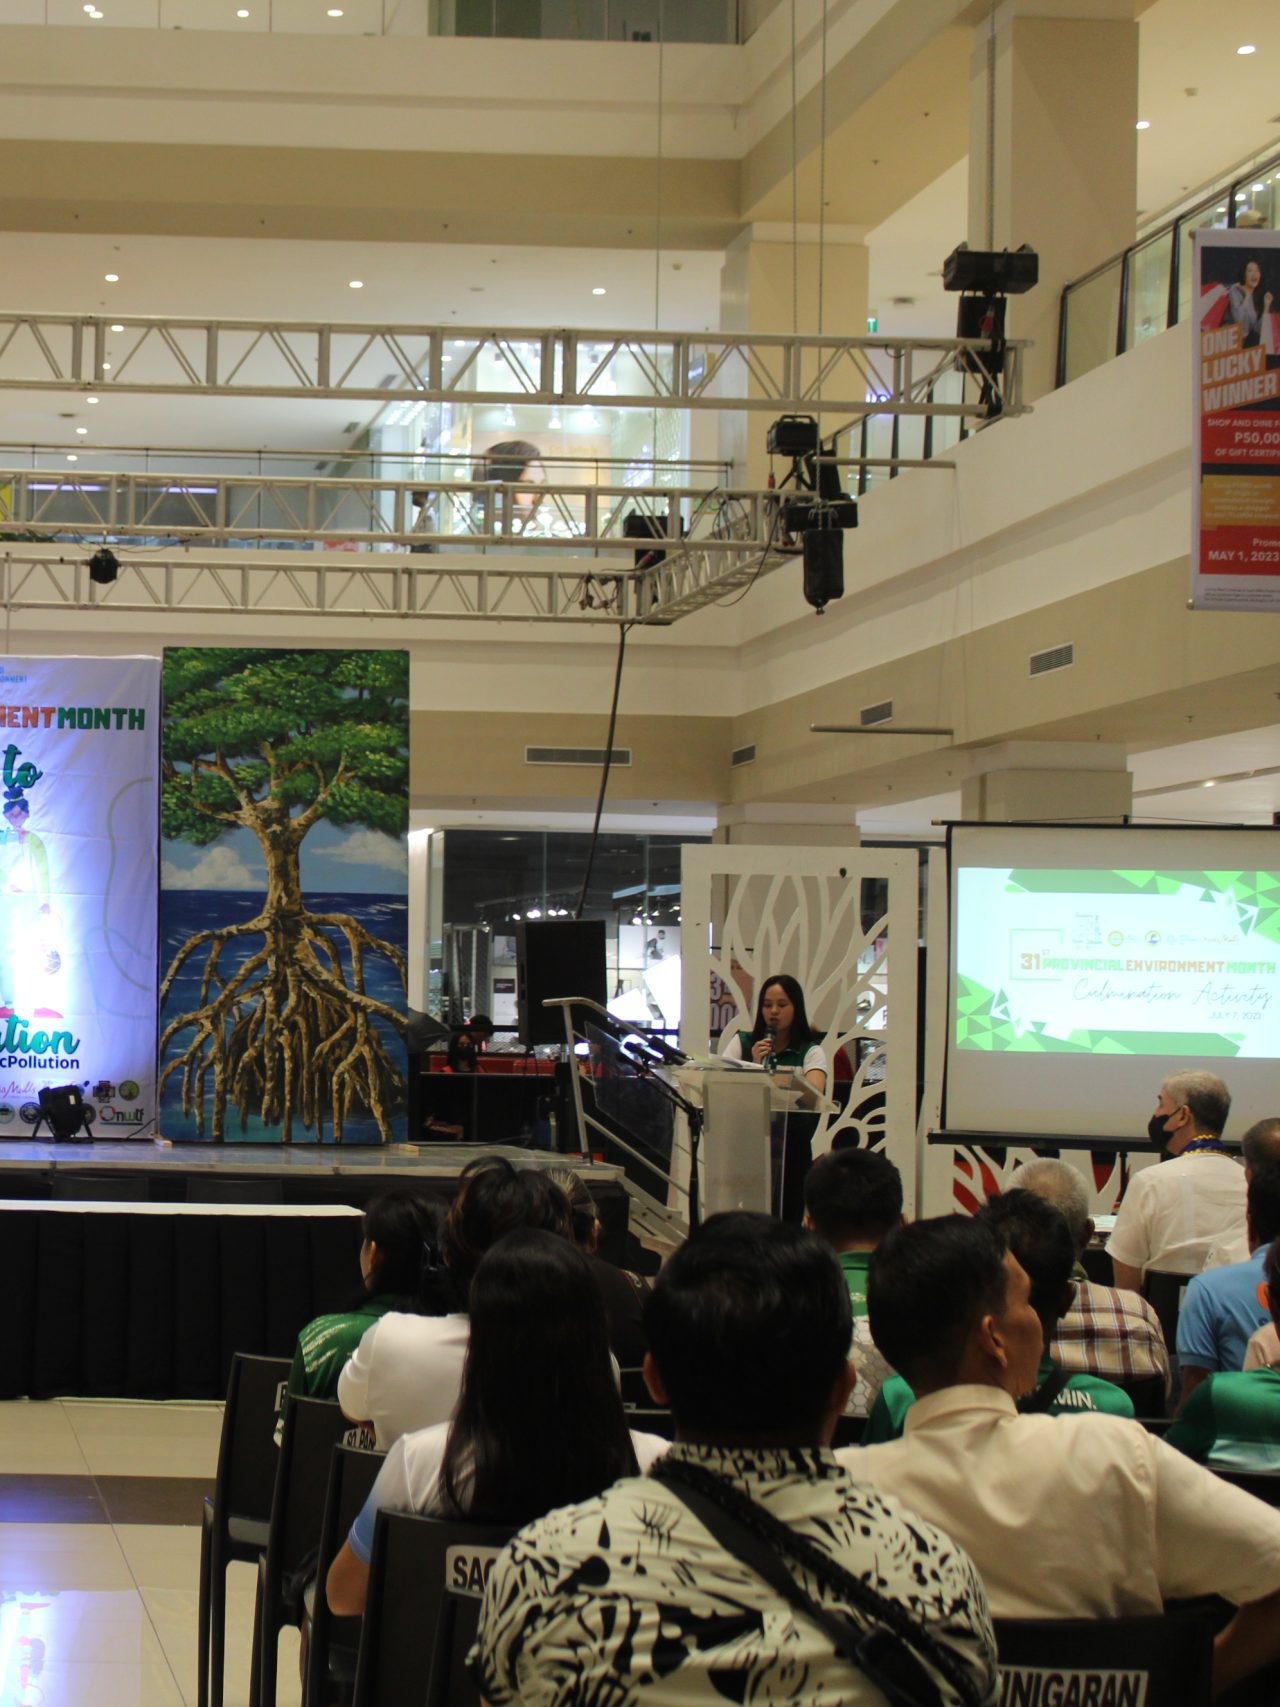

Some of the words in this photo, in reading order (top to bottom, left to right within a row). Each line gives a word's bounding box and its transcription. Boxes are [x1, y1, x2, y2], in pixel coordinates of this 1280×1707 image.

[1202, 327, 1238, 357] ONE
[1202, 348, 1262, 385] LUCKY
[1203, 373, 1277, 412] WINNER
[1207, 419, 1231, 427] SHOP
[1232, 419, 1251, 428] AND
[1252, 420, 1272, 428] DINE
[1208, 550, 1236, 560] MAY
[1250, 551, 1280, 562] 2023
[57, 707, 145, 731] MONTH
[2, 743, 43, 788] to
[1126, 959, 1225, 973] ENVIRONMENT
[999, 1670, 1141, 1707] INIGARAN
